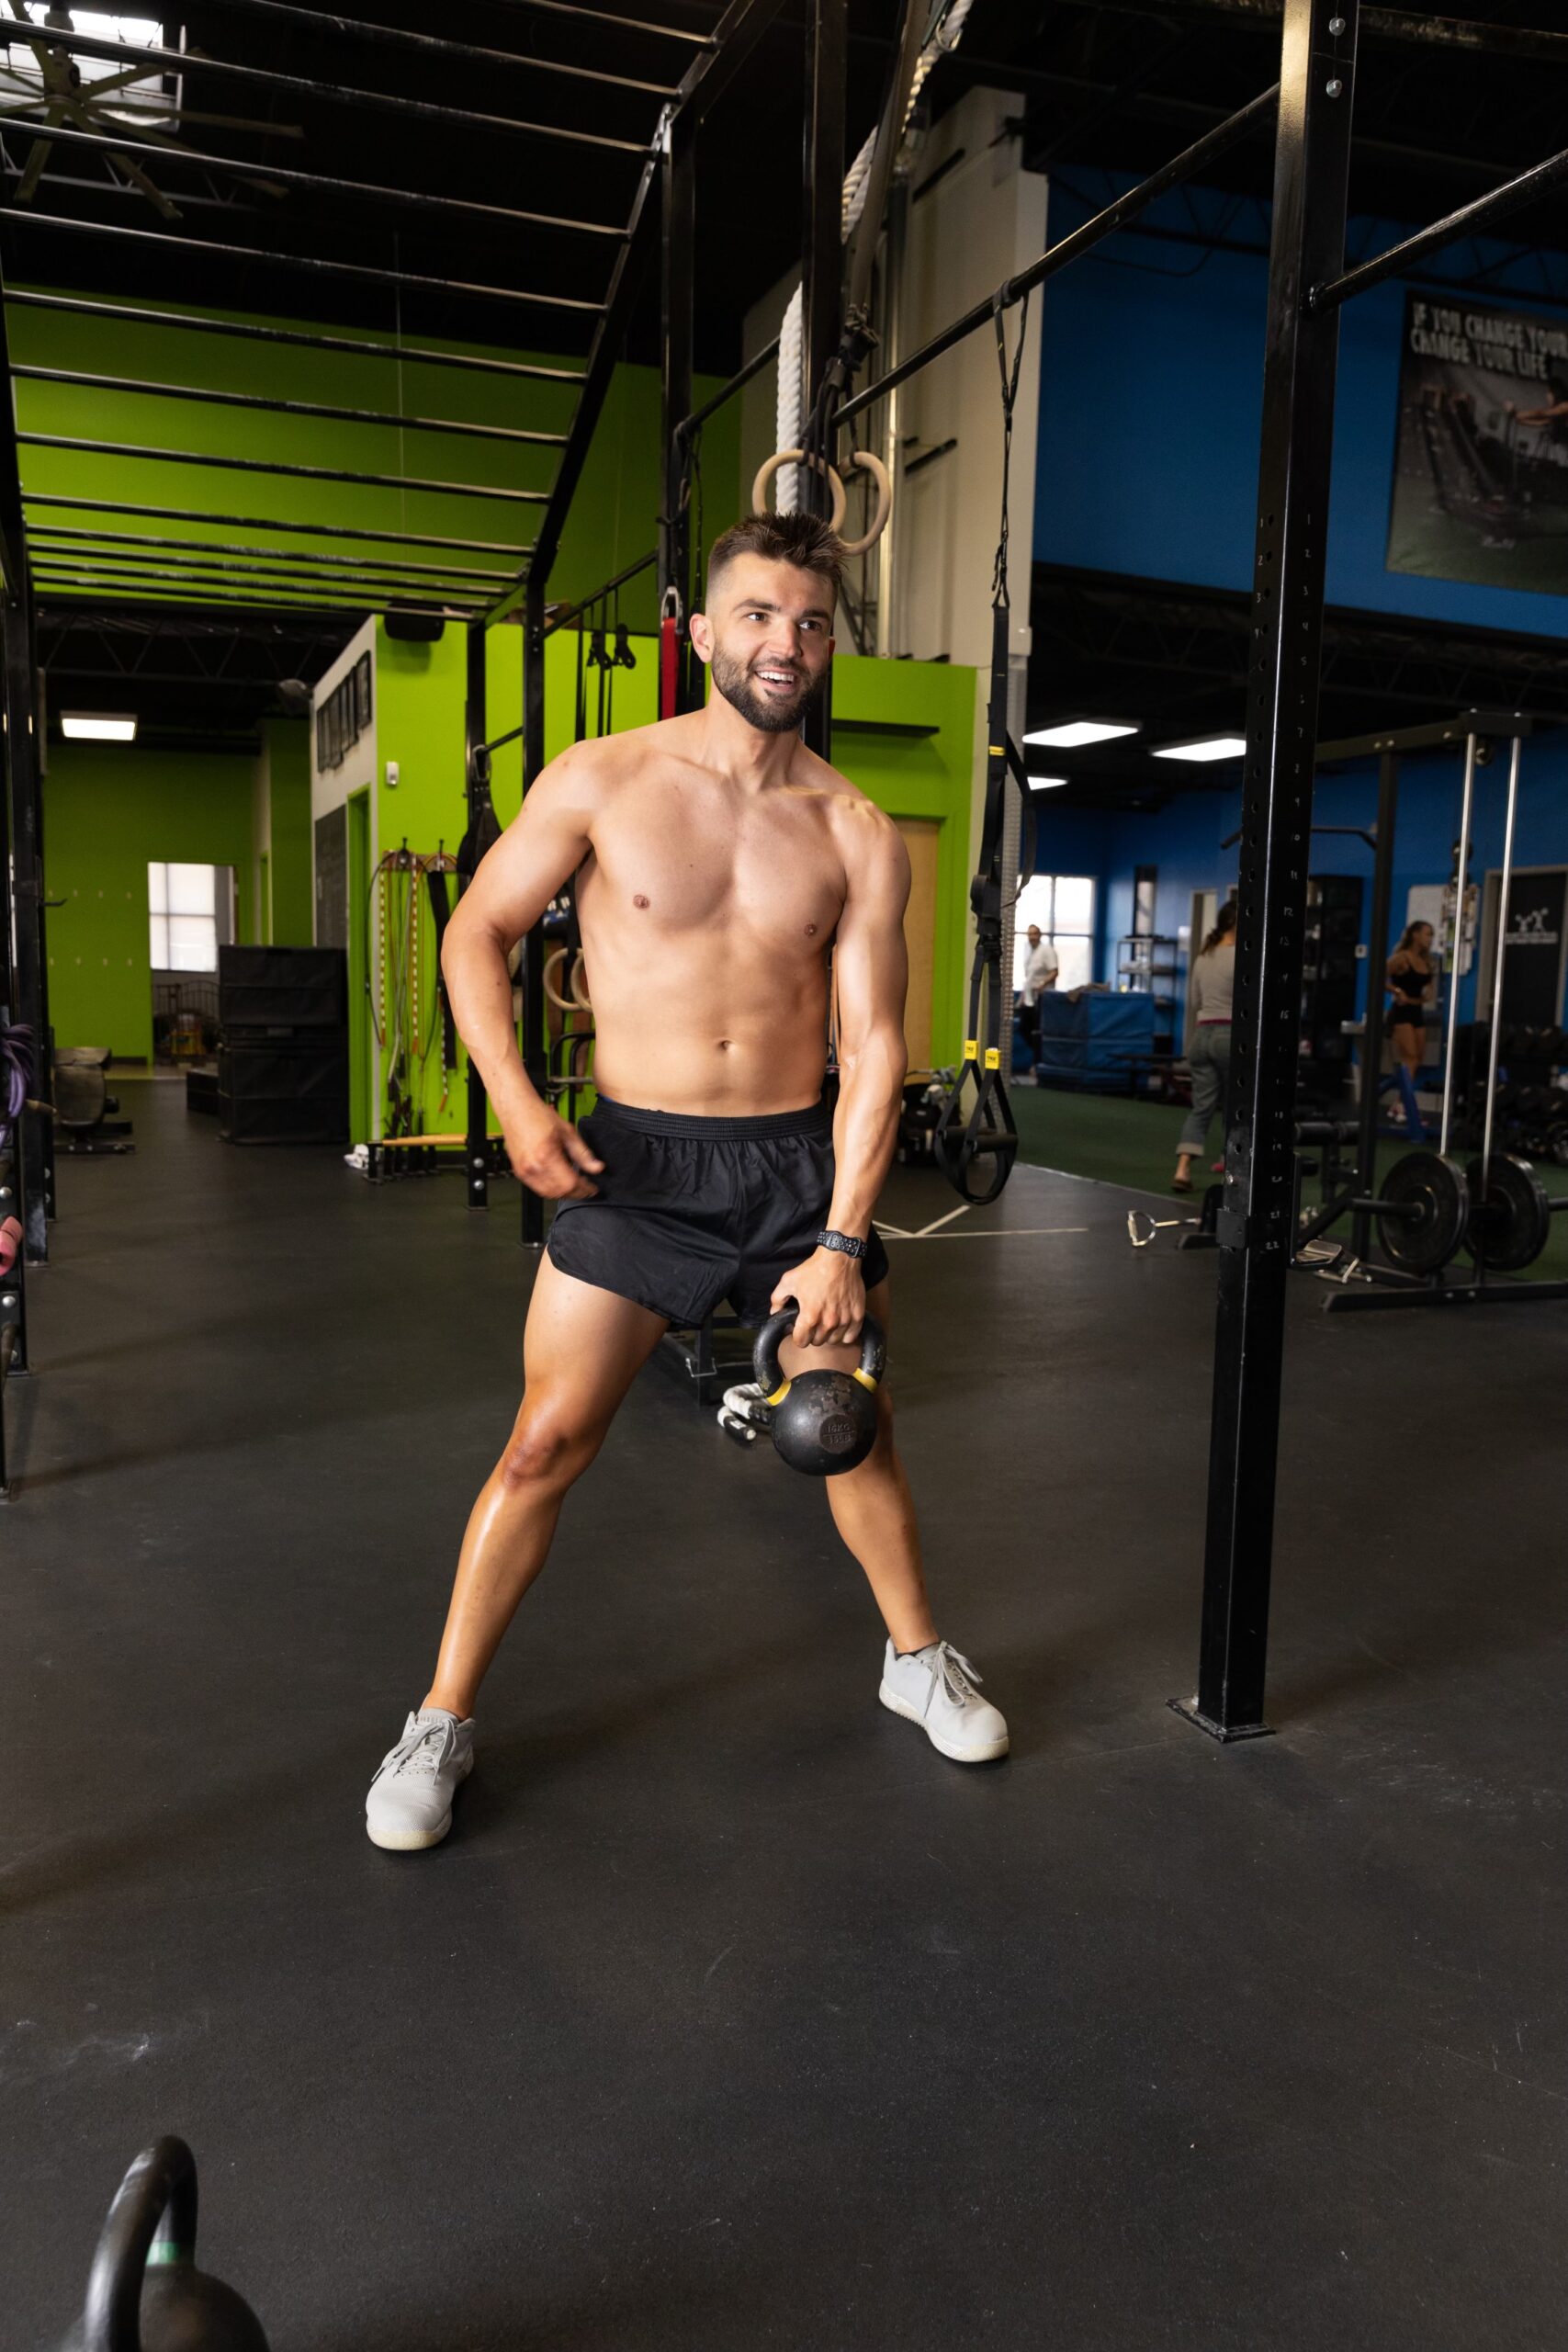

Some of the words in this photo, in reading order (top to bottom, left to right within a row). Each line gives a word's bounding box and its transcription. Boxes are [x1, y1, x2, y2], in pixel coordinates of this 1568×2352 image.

[1412, 301, 1427, 325] IF
[1430, 306, 1461, 336] YOU
[1464, 313, 1525, 348] CHANGE
[1526, 326, 1568, 359] YOUR
[1410, 327, 1471, 363] CHANGE
[1473, 341, 1516, 373] YOUR
[1517, 349, 1549, 380] LIFE
[1304, 548, 1312, 559] 2
[1258, 555, 1264, 566] 2
[1257, 592, 1262, 604] 3
[1297, 727, 1303, 739] 7
[1265, 1240, 1280, 1250] 22
